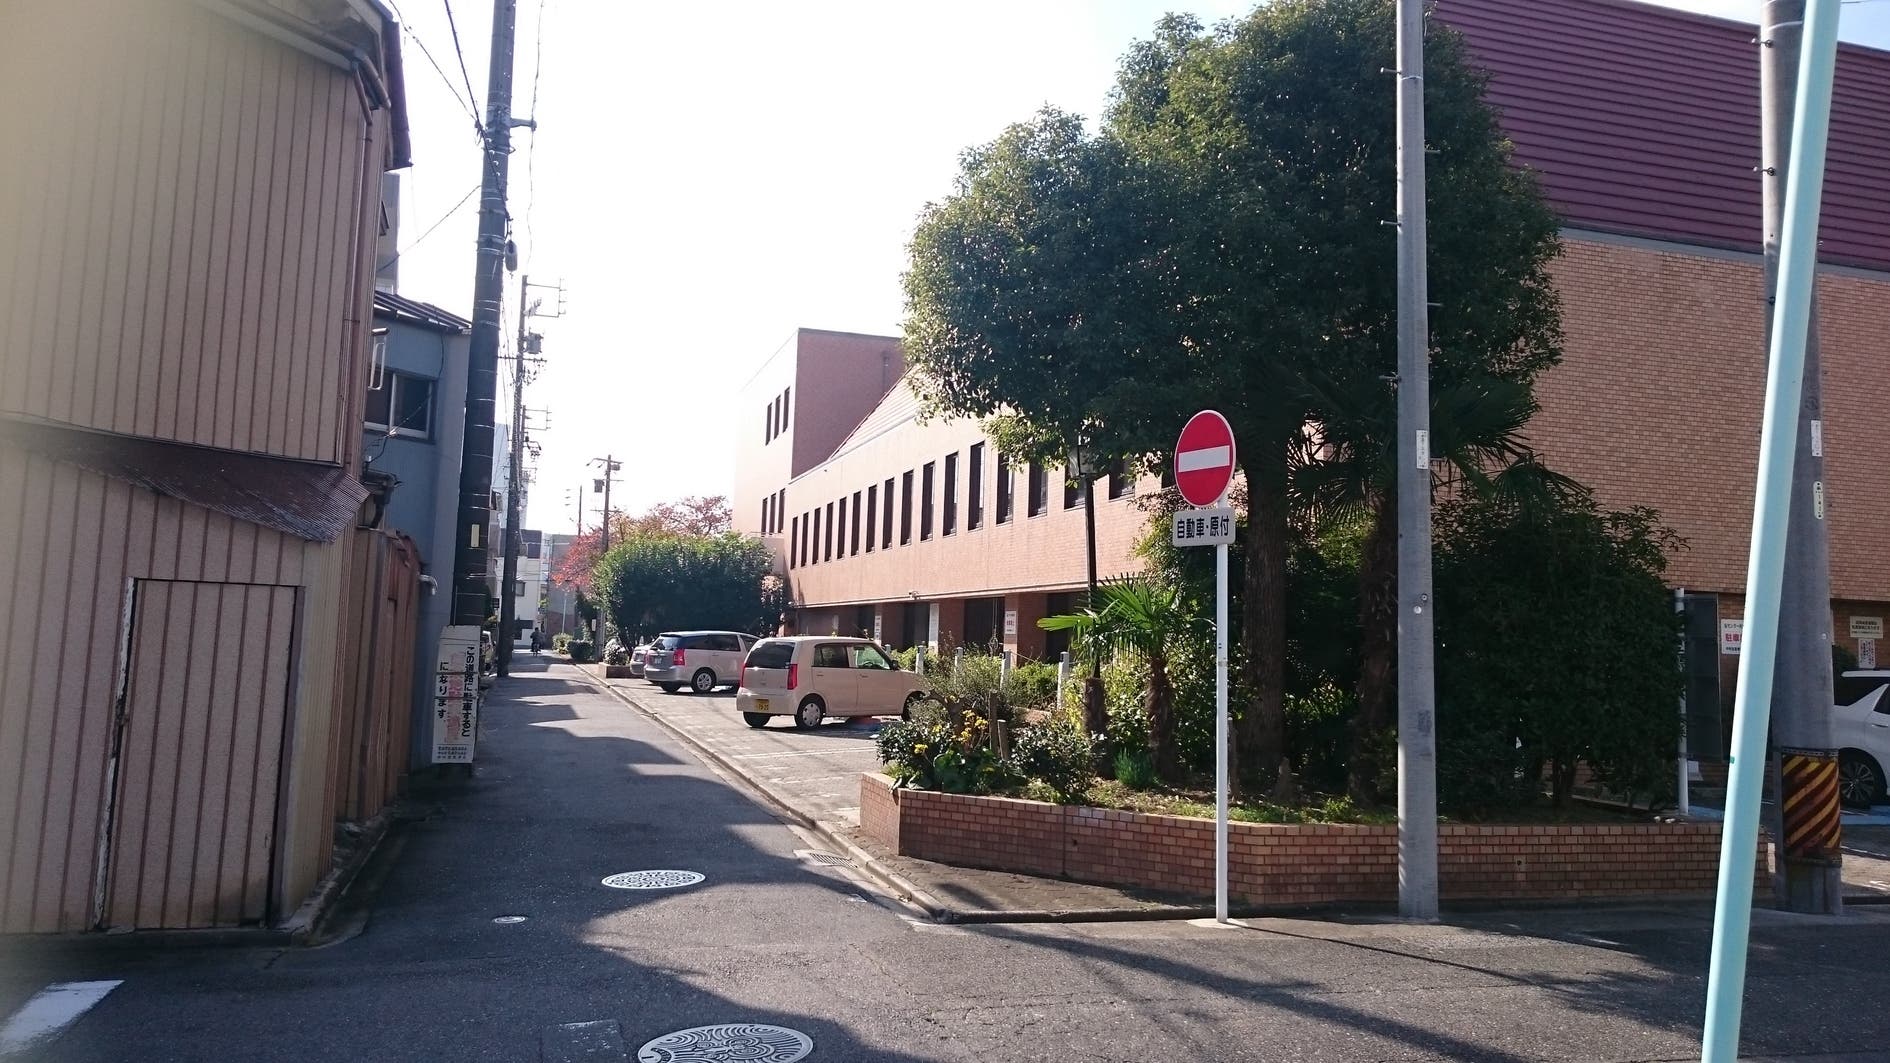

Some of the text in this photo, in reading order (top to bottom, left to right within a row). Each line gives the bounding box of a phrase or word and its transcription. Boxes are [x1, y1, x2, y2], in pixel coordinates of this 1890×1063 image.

[1177, 515, 1230, 538] 自動車・原付
